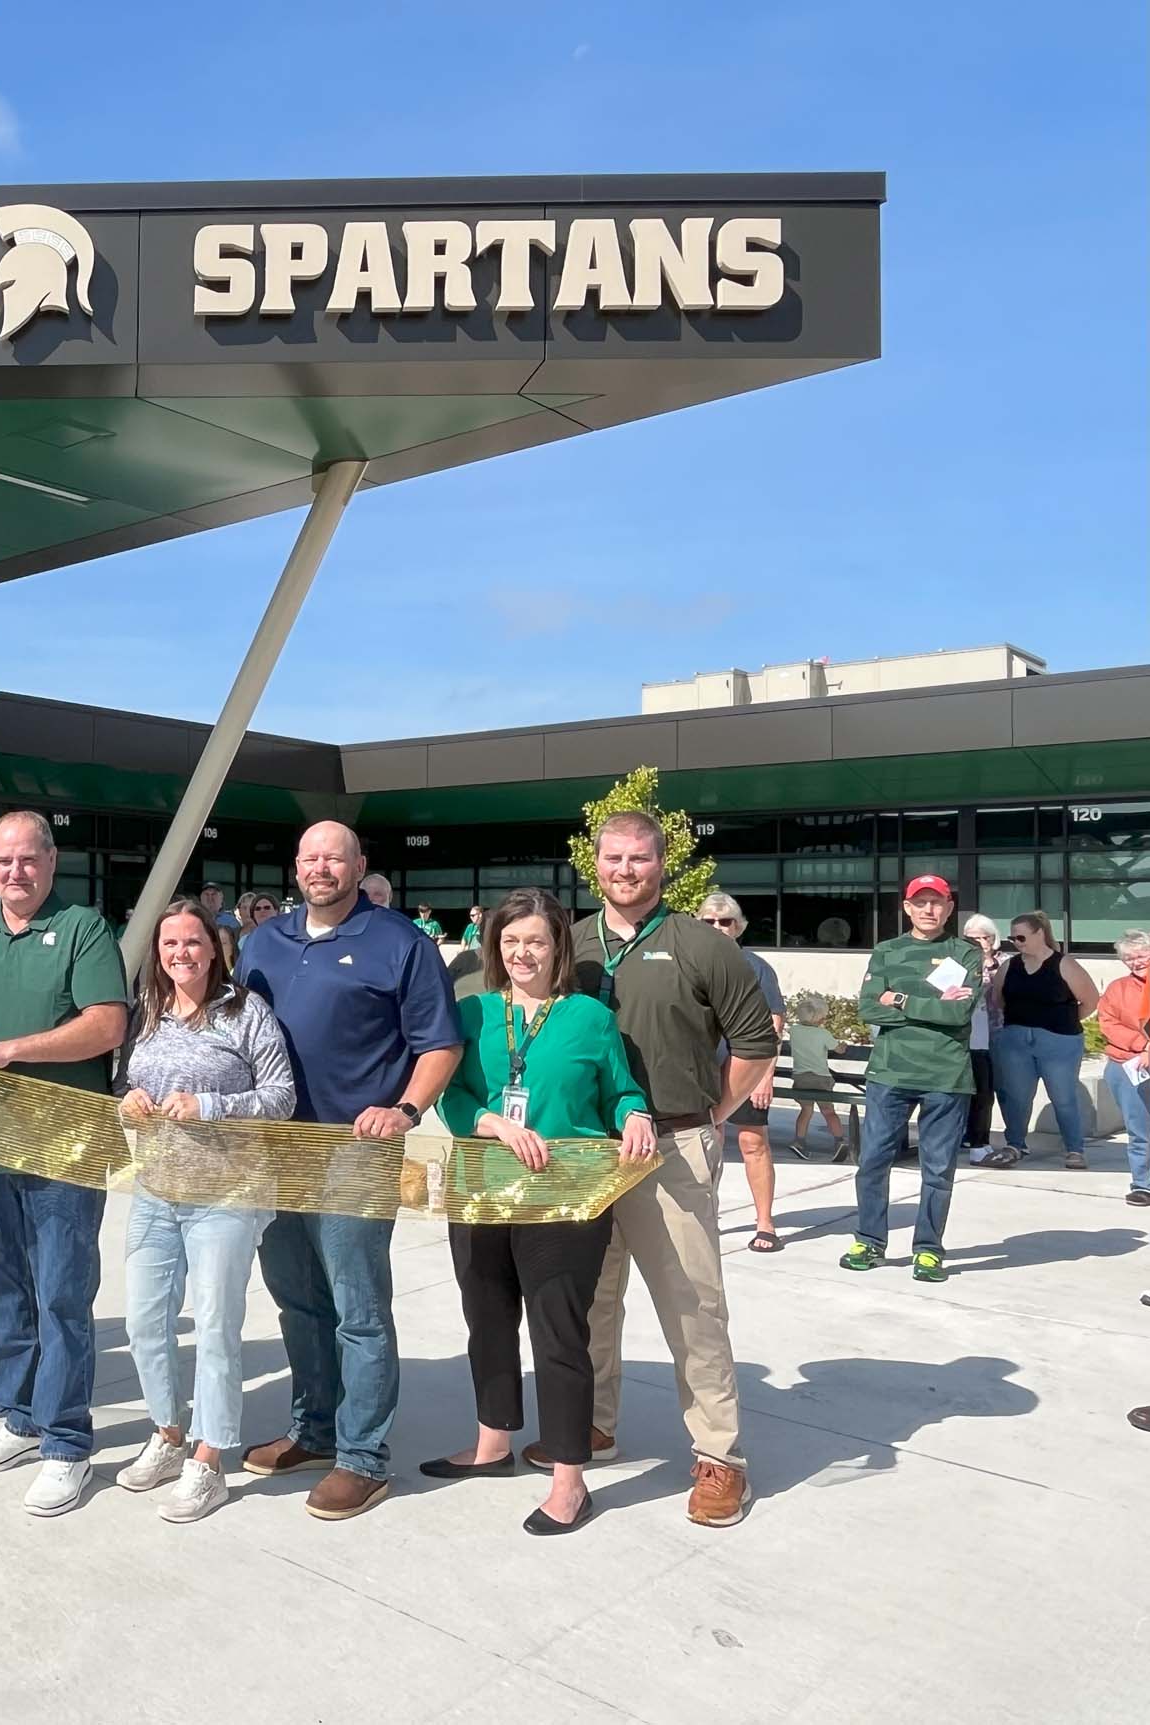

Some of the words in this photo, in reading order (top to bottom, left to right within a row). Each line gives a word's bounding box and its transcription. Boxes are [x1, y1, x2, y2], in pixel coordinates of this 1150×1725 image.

[194, 217, 785, 317] SPARTANS
[53, 814, 70, 827] 104
[1071, 807, 1102, 822] 120
[696, 823, 715, 836] 119
[406, 835, 430, 847] 109B
